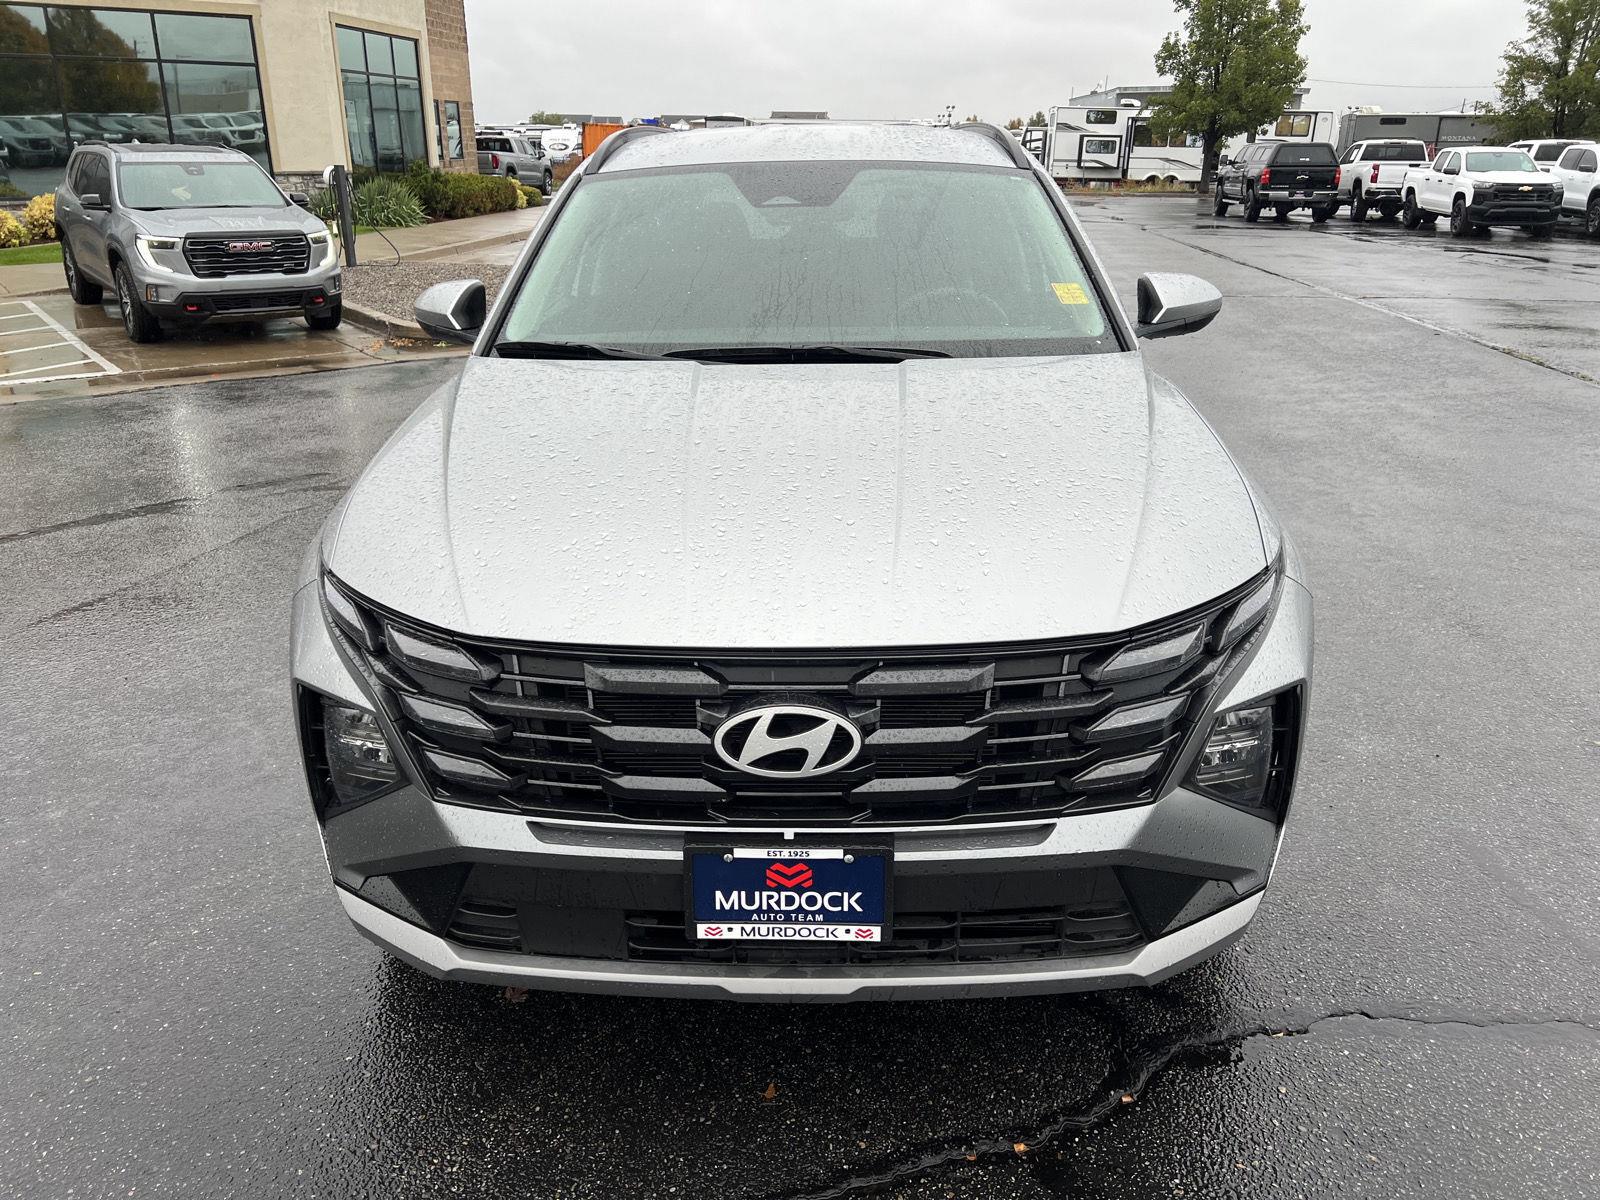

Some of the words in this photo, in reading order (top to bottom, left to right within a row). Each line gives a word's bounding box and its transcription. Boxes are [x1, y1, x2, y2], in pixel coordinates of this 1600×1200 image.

[229, 242, 272, 253] GMC
[788, 850, 810, 858] 1925
[715, 890, 863, 912] MURDOCK
[751, 913, 785, 922] AUTO
[790, 913, 824, 922] TEAM
[740, 926, 839, 939] MURDOCK
